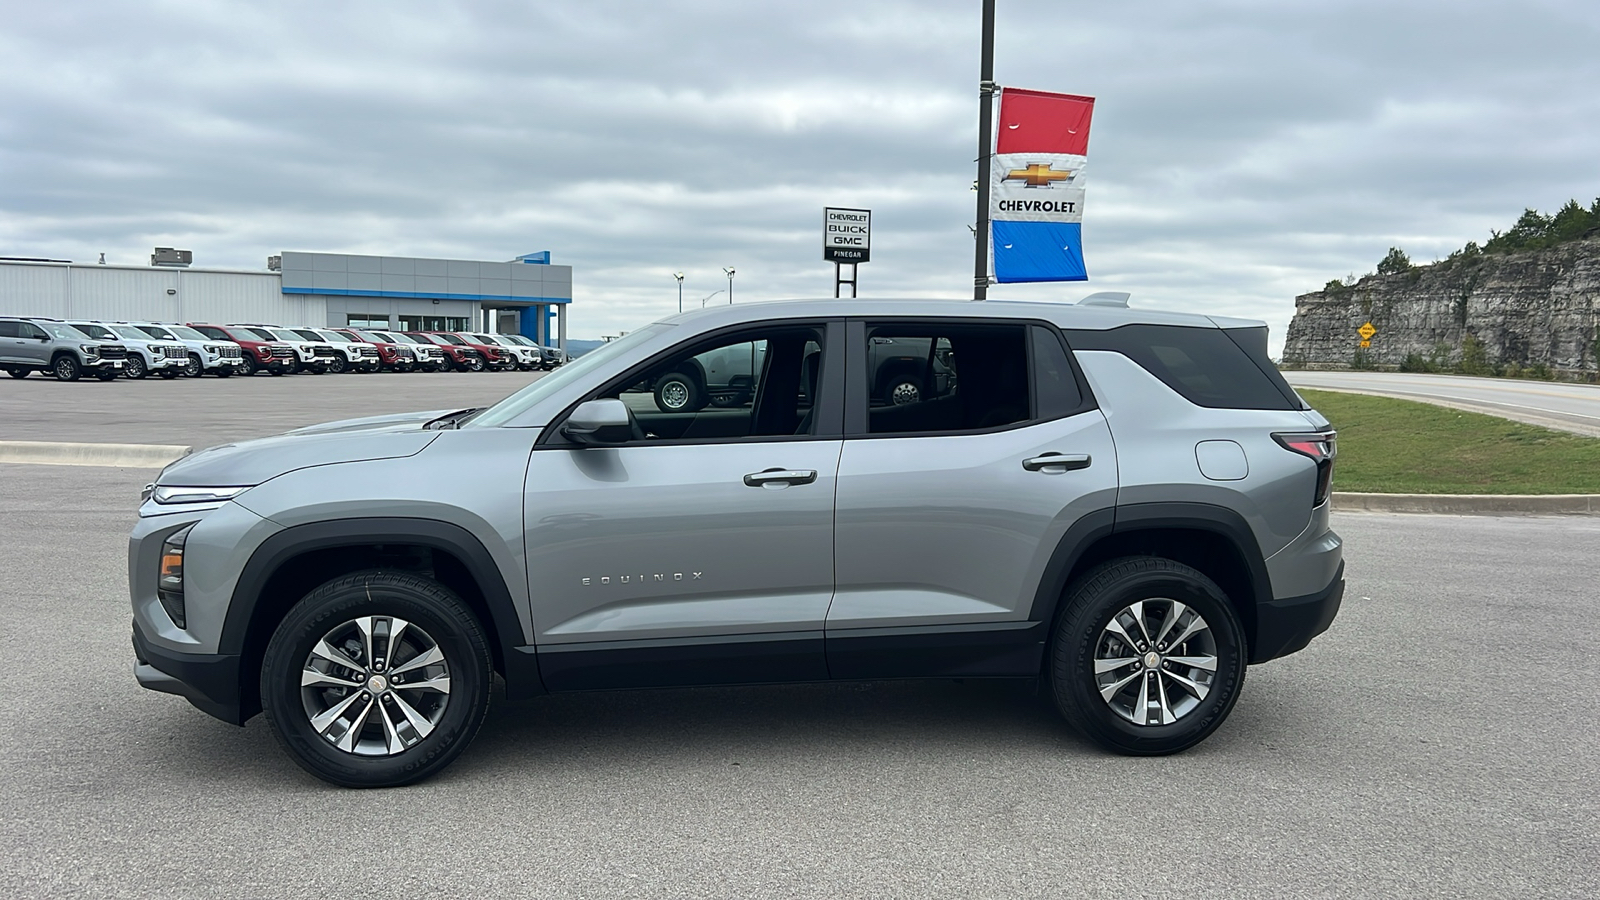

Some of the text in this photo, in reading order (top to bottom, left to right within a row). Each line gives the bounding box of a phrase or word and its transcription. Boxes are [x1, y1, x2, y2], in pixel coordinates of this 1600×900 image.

[829, 213, 868, 222] CHEVROLET
[828, 224, 868, 234] BUICK
[833, 236, 863, 246] GMC
[833, 250, 862, 258] PINEGAR
[581, 571, 702, 586] EQUINOX
